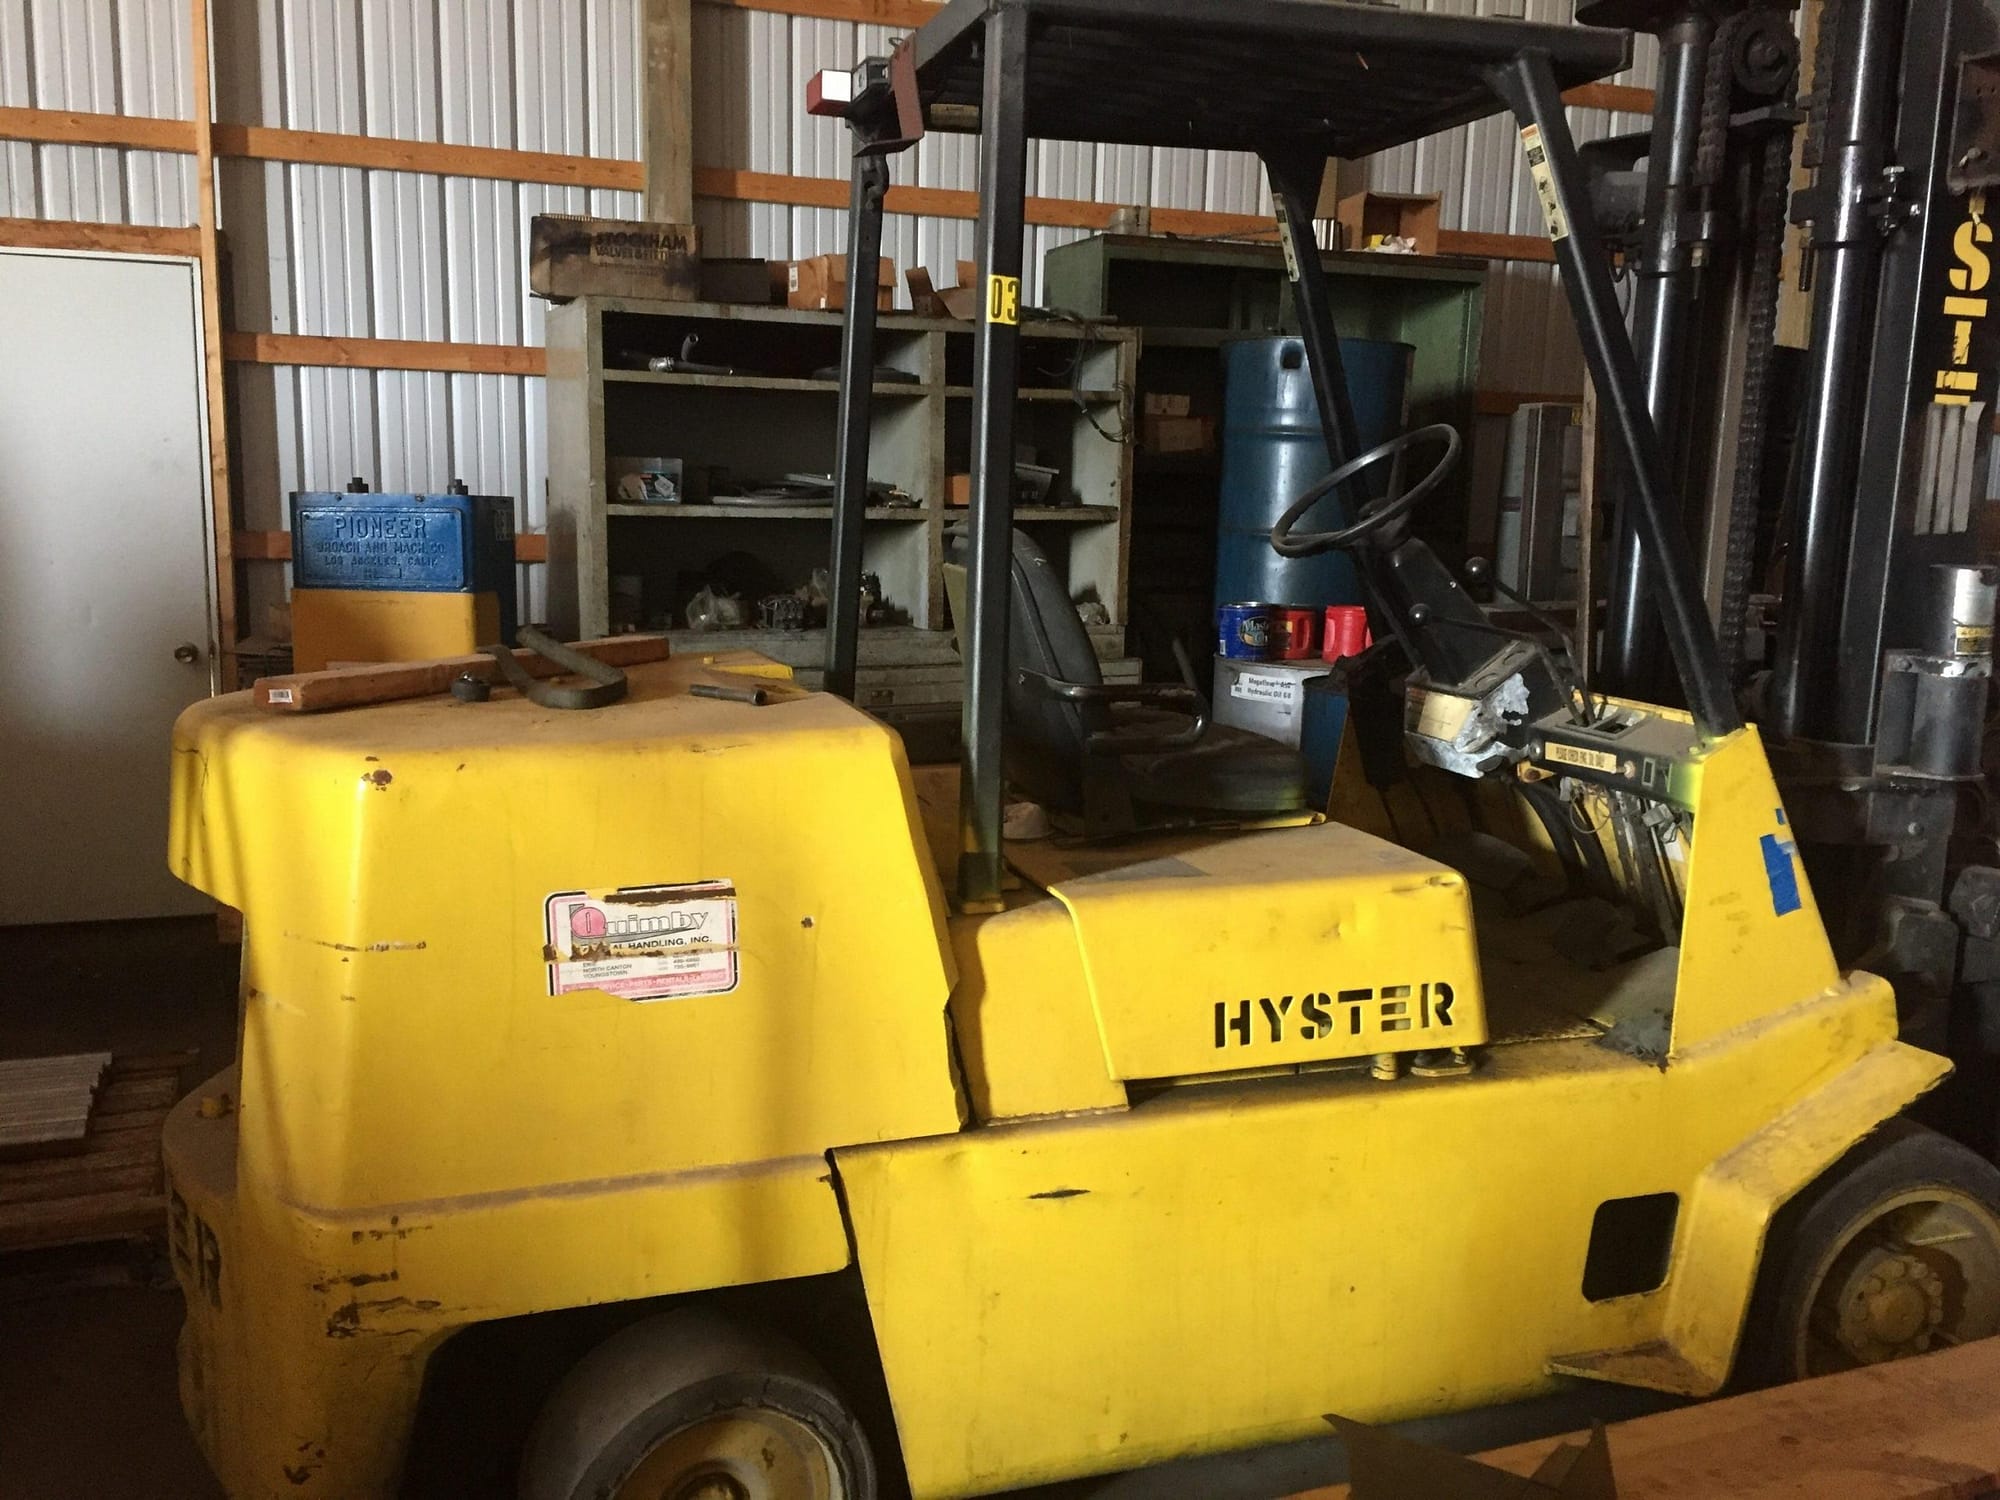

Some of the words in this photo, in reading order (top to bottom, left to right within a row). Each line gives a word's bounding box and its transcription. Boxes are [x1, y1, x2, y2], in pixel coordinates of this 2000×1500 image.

[991, 277, 1019, 321] 03
[335, 515, 427, 539] PIONEER
[366, 541, 388, 553] AND
[324, 556, 343, 566] LOS
[571, 906, 708, 938] Quimby
[690, 935, 712, 944] INC.
[1214, 981, 1455, 1049] HYSTER
